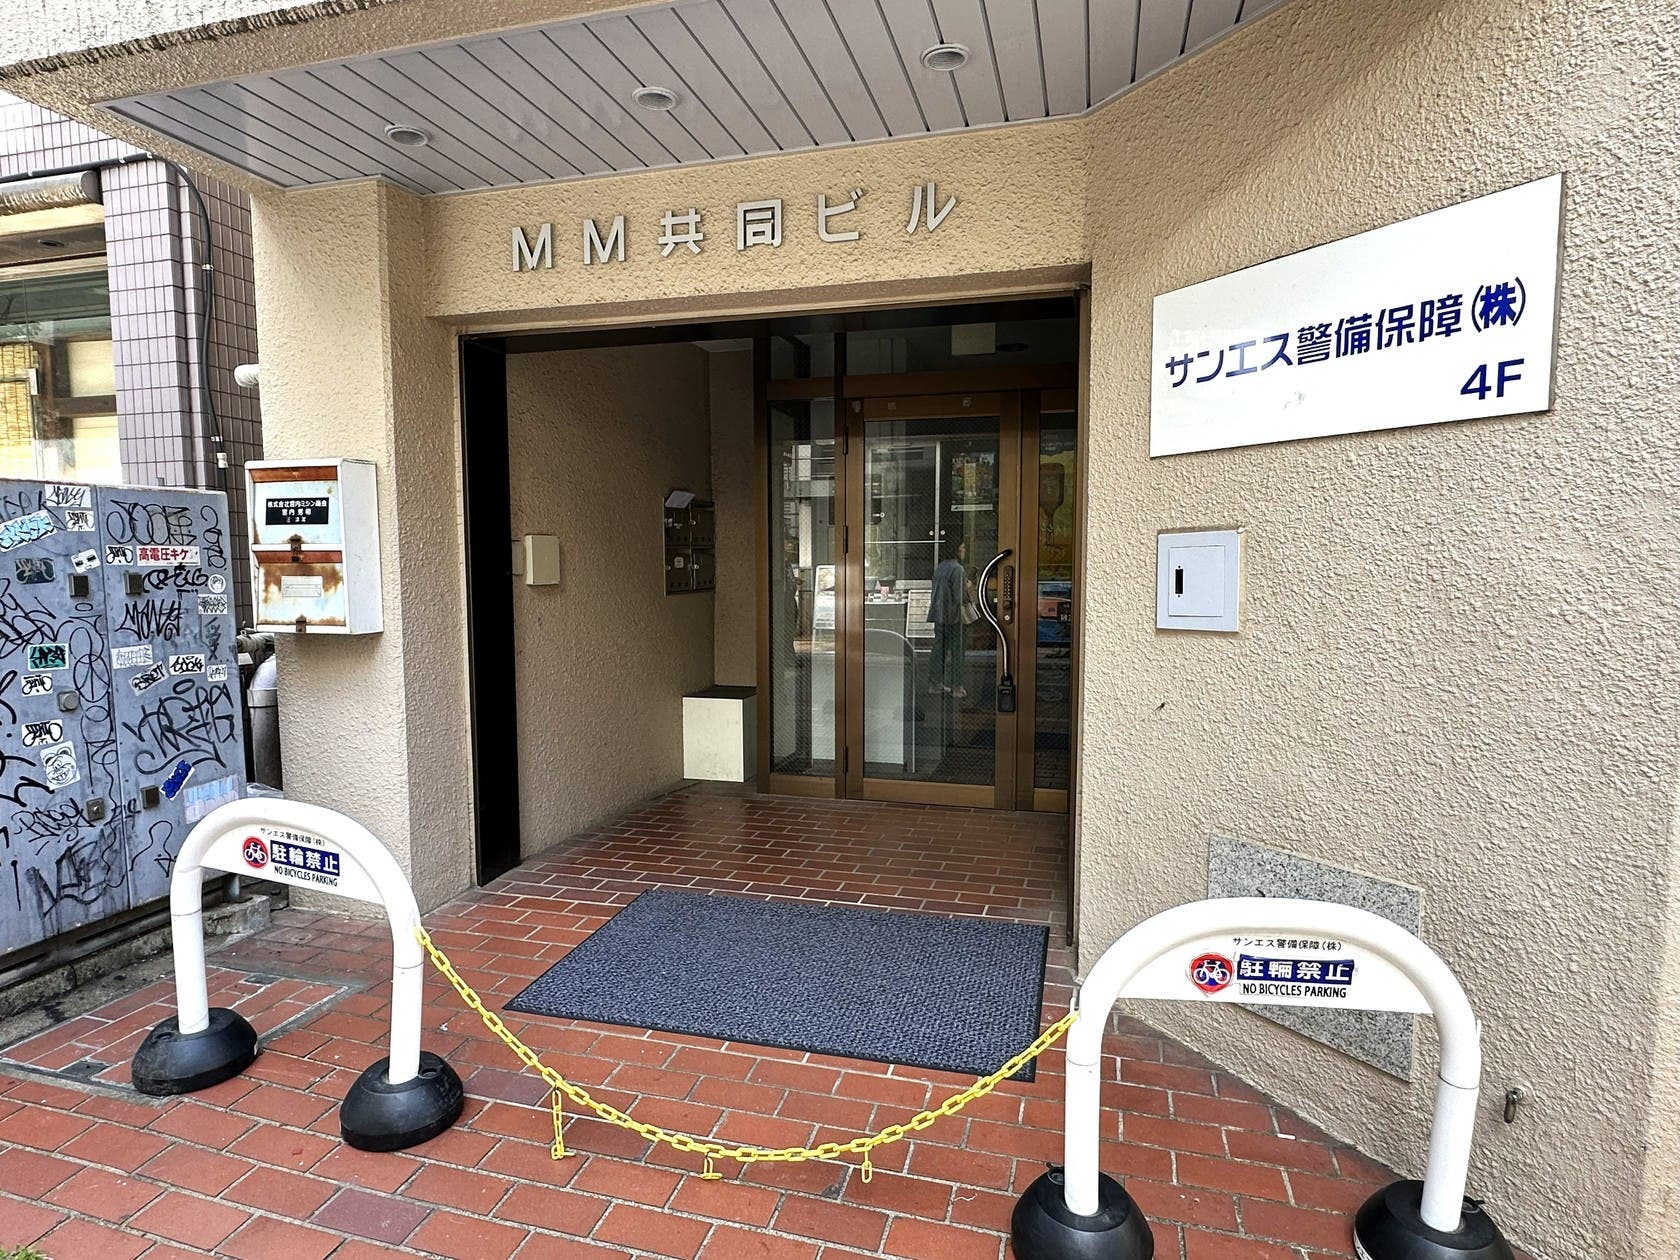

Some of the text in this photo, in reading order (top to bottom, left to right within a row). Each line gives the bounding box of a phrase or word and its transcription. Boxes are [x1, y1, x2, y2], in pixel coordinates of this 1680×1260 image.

[511, 182, 957, 272] MM共同ビル
[1165, 277, 1526, 388] サンエス警備保障(株)
[1460, 358, 1525, 400] 4F
[271, 843, 339, 873] 駐輪禁止
[274, 865, 338, 887] NO BICYCLES PARKING
[1233, 937, 1342, 951] サンエス警備保障(株)
[1243, 983, 1347, 998] NO BICYCLES PARKING
